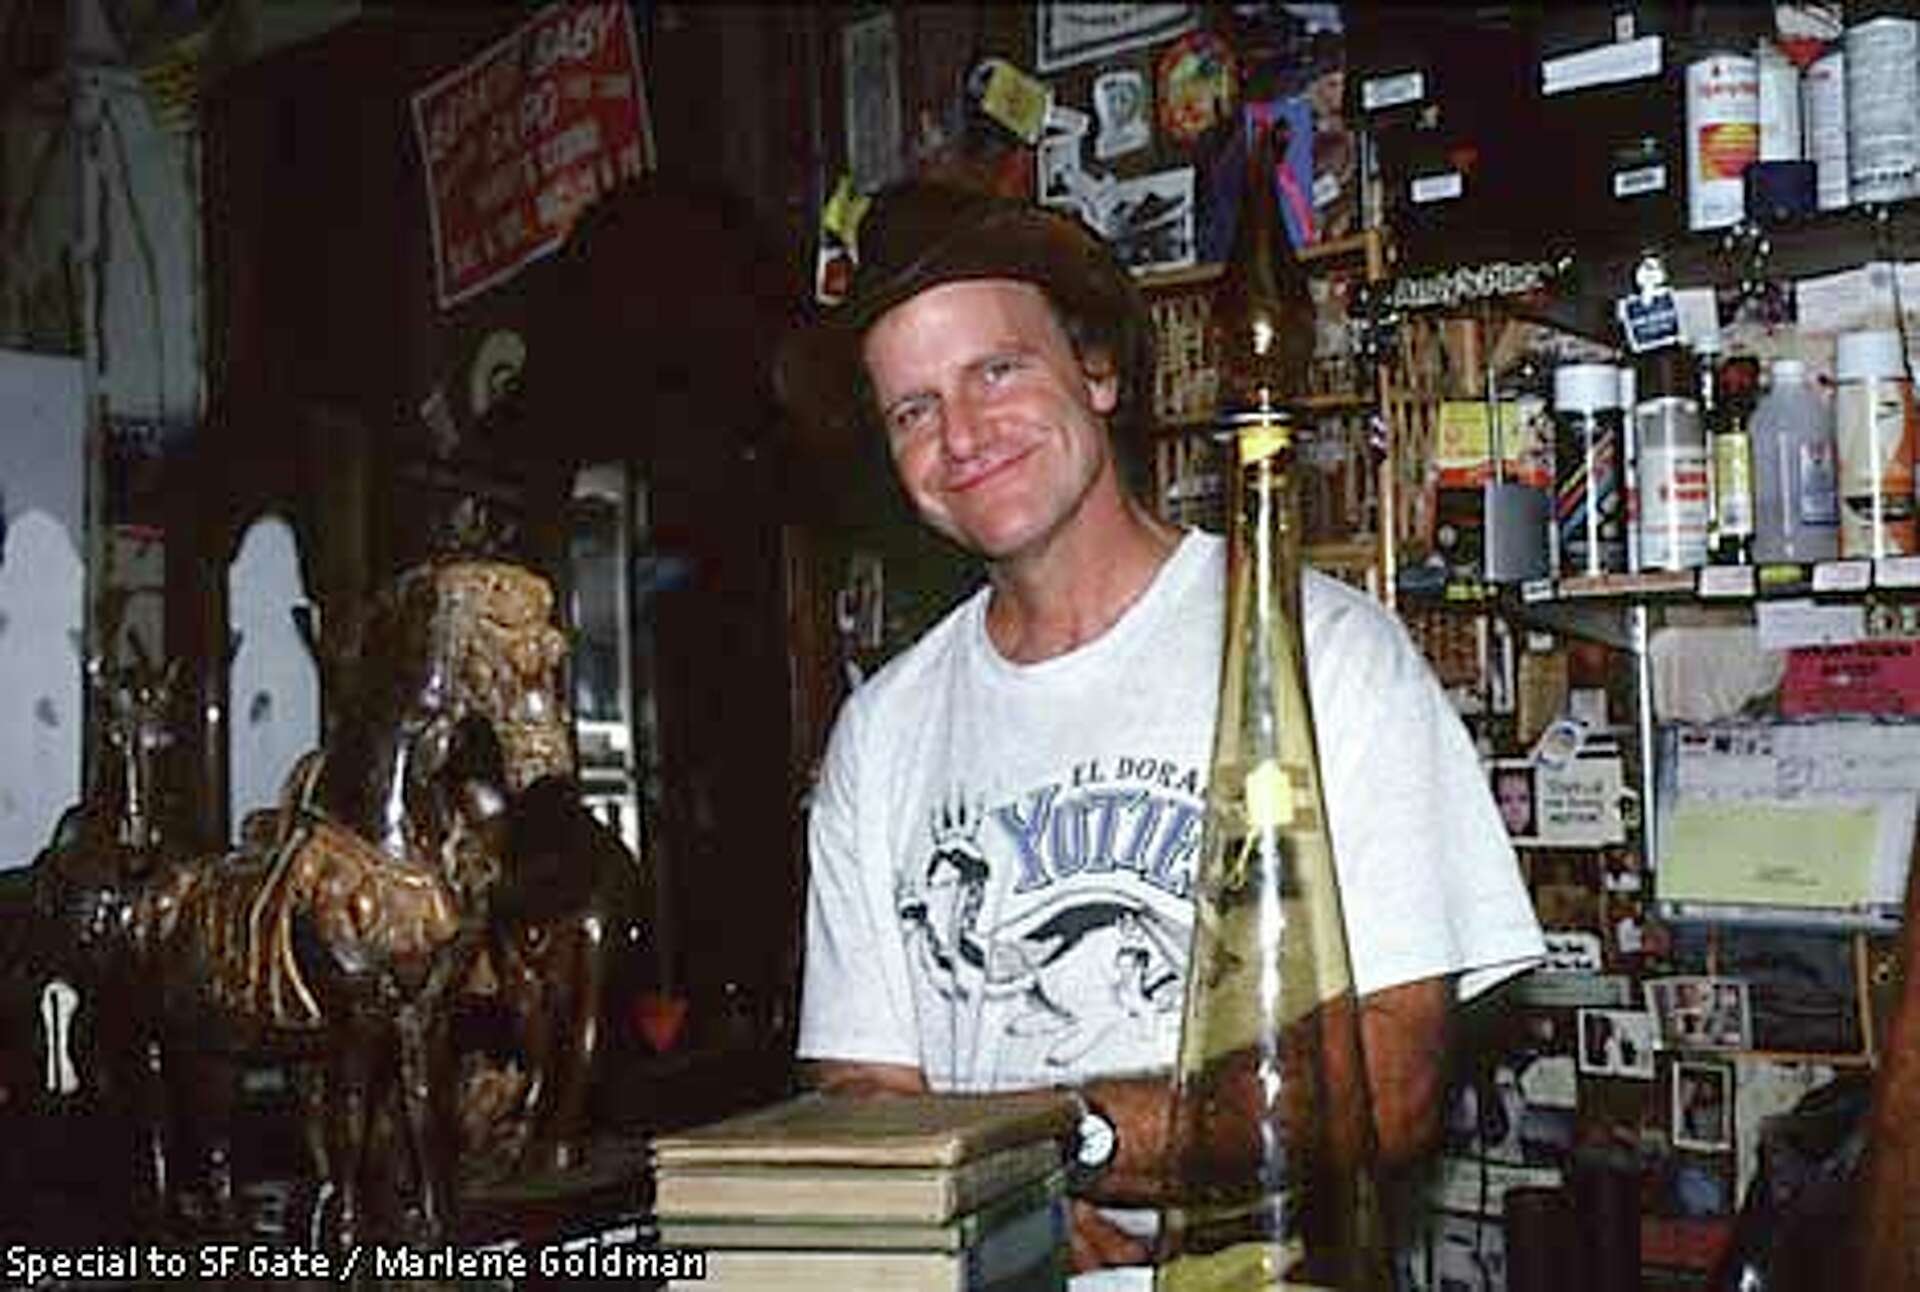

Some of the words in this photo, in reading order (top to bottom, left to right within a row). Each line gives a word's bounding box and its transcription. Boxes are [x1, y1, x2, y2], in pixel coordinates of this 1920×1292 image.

[1072, 761, 1105, 787] EL
[1115, 757, 1200, 794] DORA
[994, 782, 1204, 899] YOTTE
